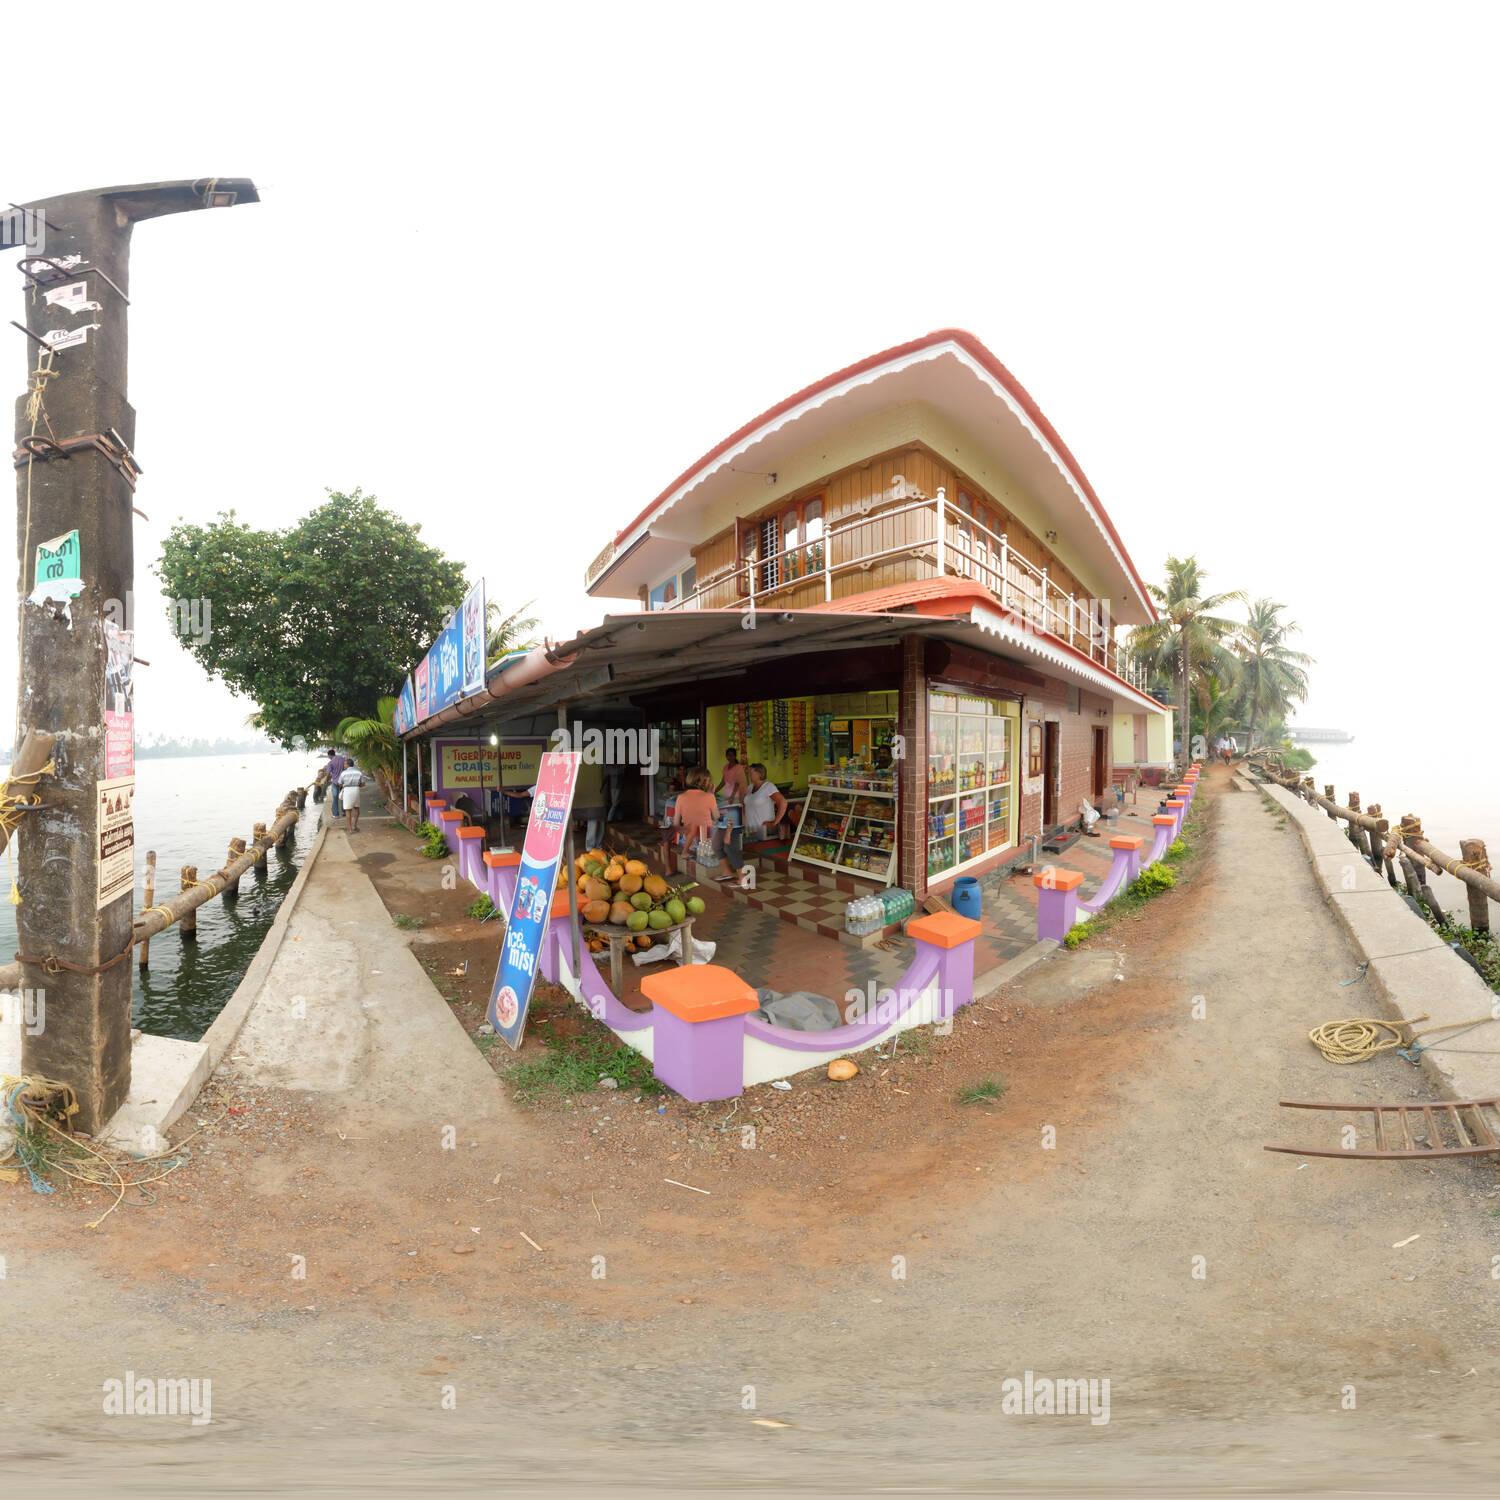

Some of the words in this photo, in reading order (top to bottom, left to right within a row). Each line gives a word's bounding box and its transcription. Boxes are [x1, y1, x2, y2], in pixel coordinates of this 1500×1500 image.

[547, 810, 563, 821] JOHN
[507, 926, 524, 948] ice
[509, 945, 535, 977] mist
